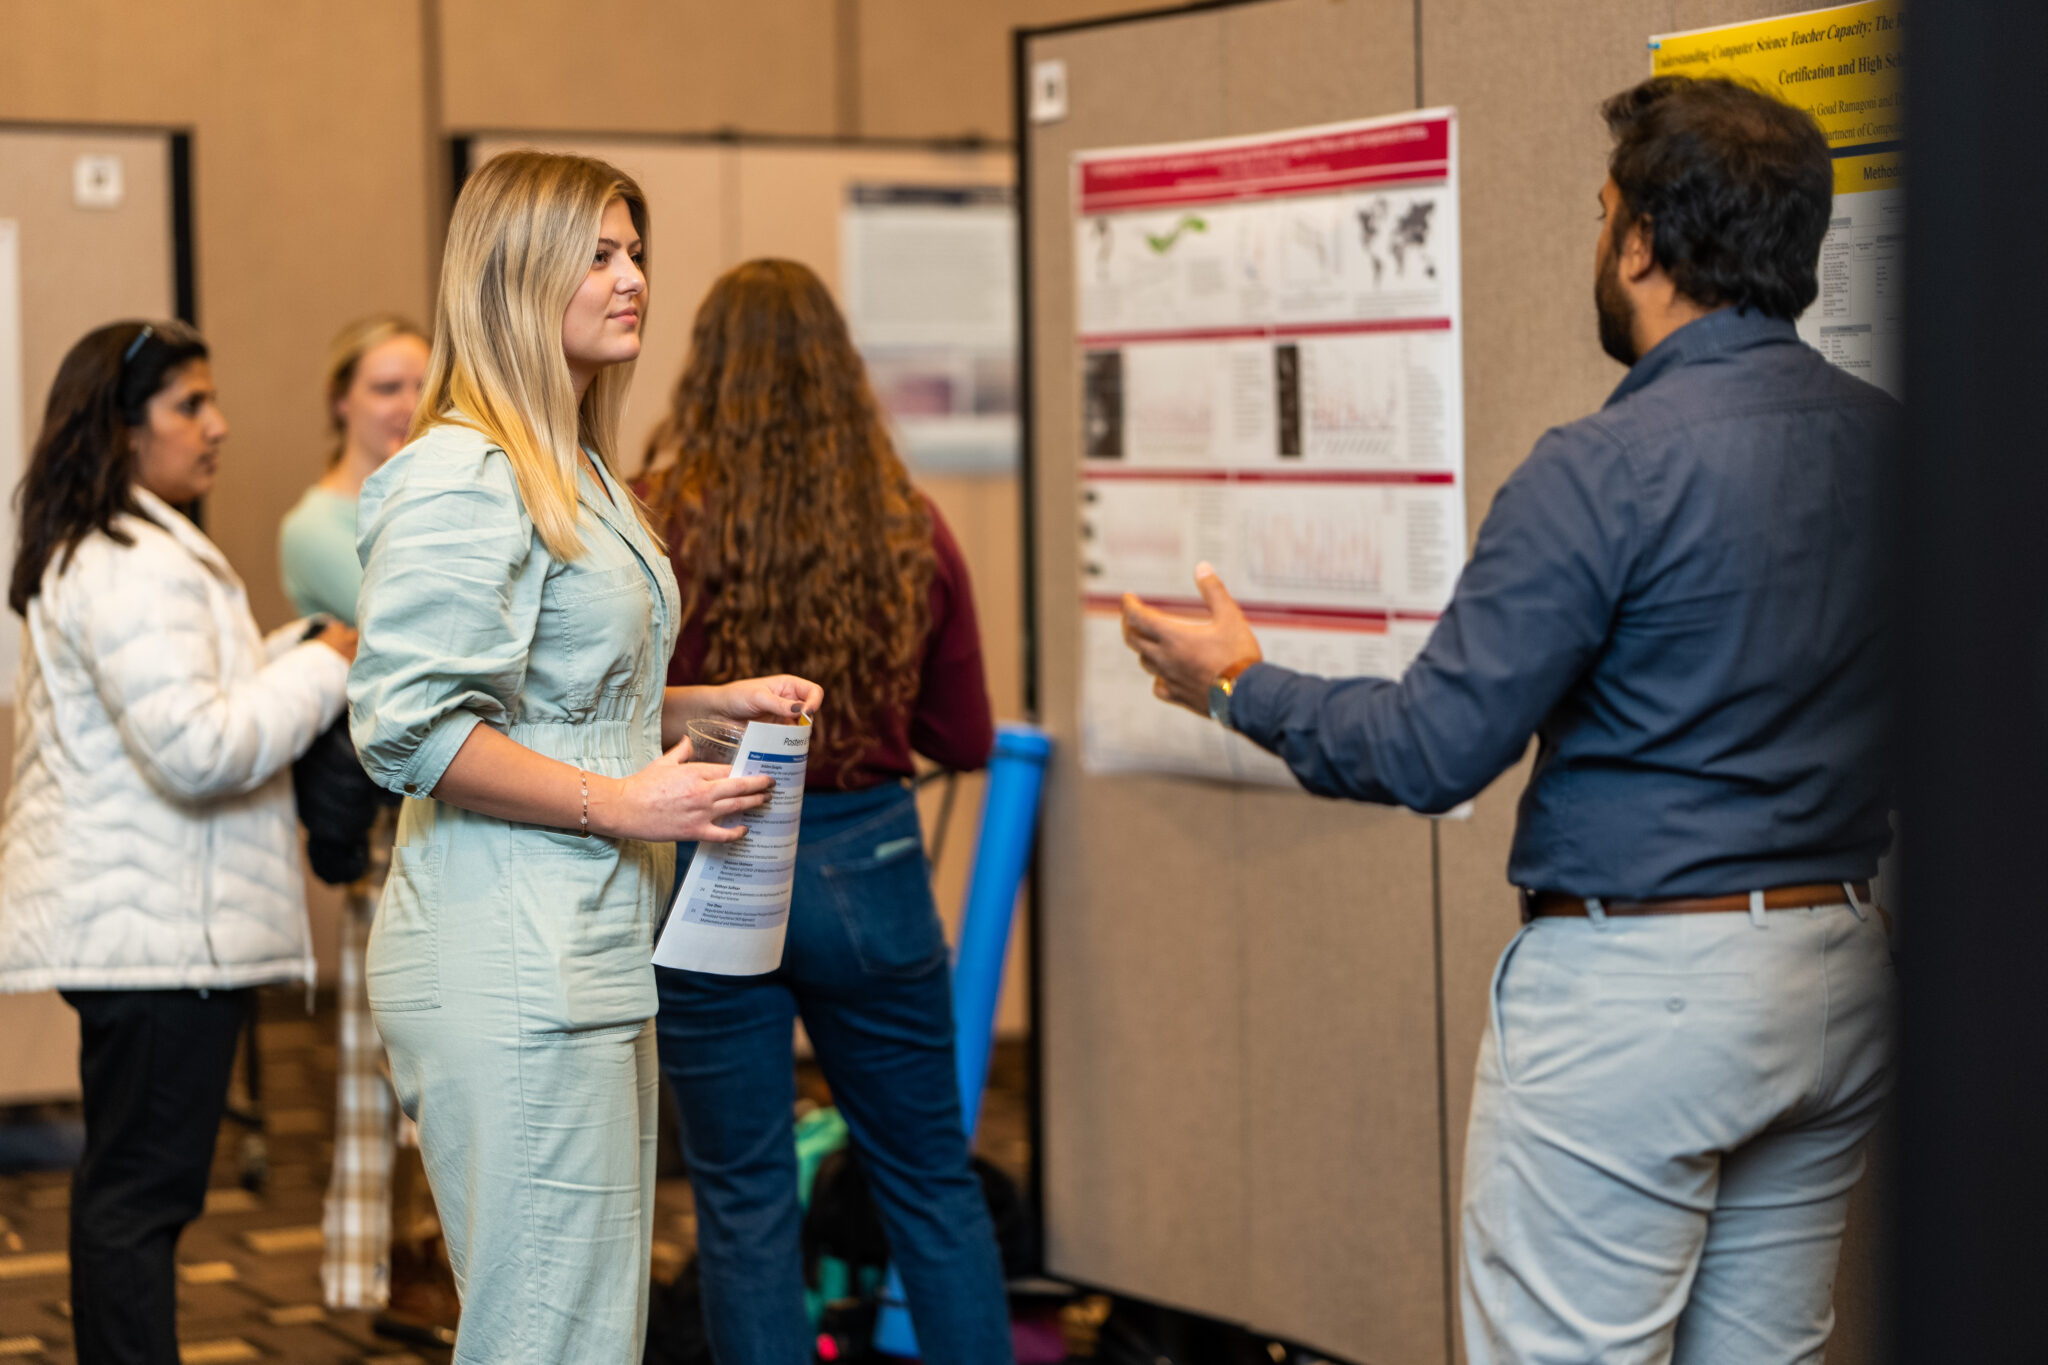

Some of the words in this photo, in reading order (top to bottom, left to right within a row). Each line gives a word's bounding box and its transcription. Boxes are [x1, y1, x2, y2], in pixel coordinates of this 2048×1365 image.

[1711, 42, 1755, 61] Computer
[1755, 36, 1788, 53] Science
[1790, 28, 1825, 46] Teacher
[1826, 21, 1872, 42] Capacity:
[1875, 15, 1894, 32] The
[1778, 63, 1835, 85] Certification
[1838, 58, 1855, 77] and
[1858, 55, 1882, 76] High
[1885, 53, 1904, 69] Sch
[1839, 96, 1877, 115] Ramagoni
[1878, 94, 1893, 109] and
[1825, 127, 1856, 142] partment
[1857, 123, 1867, 138] of
[783, 737, 804, 747] Posters
